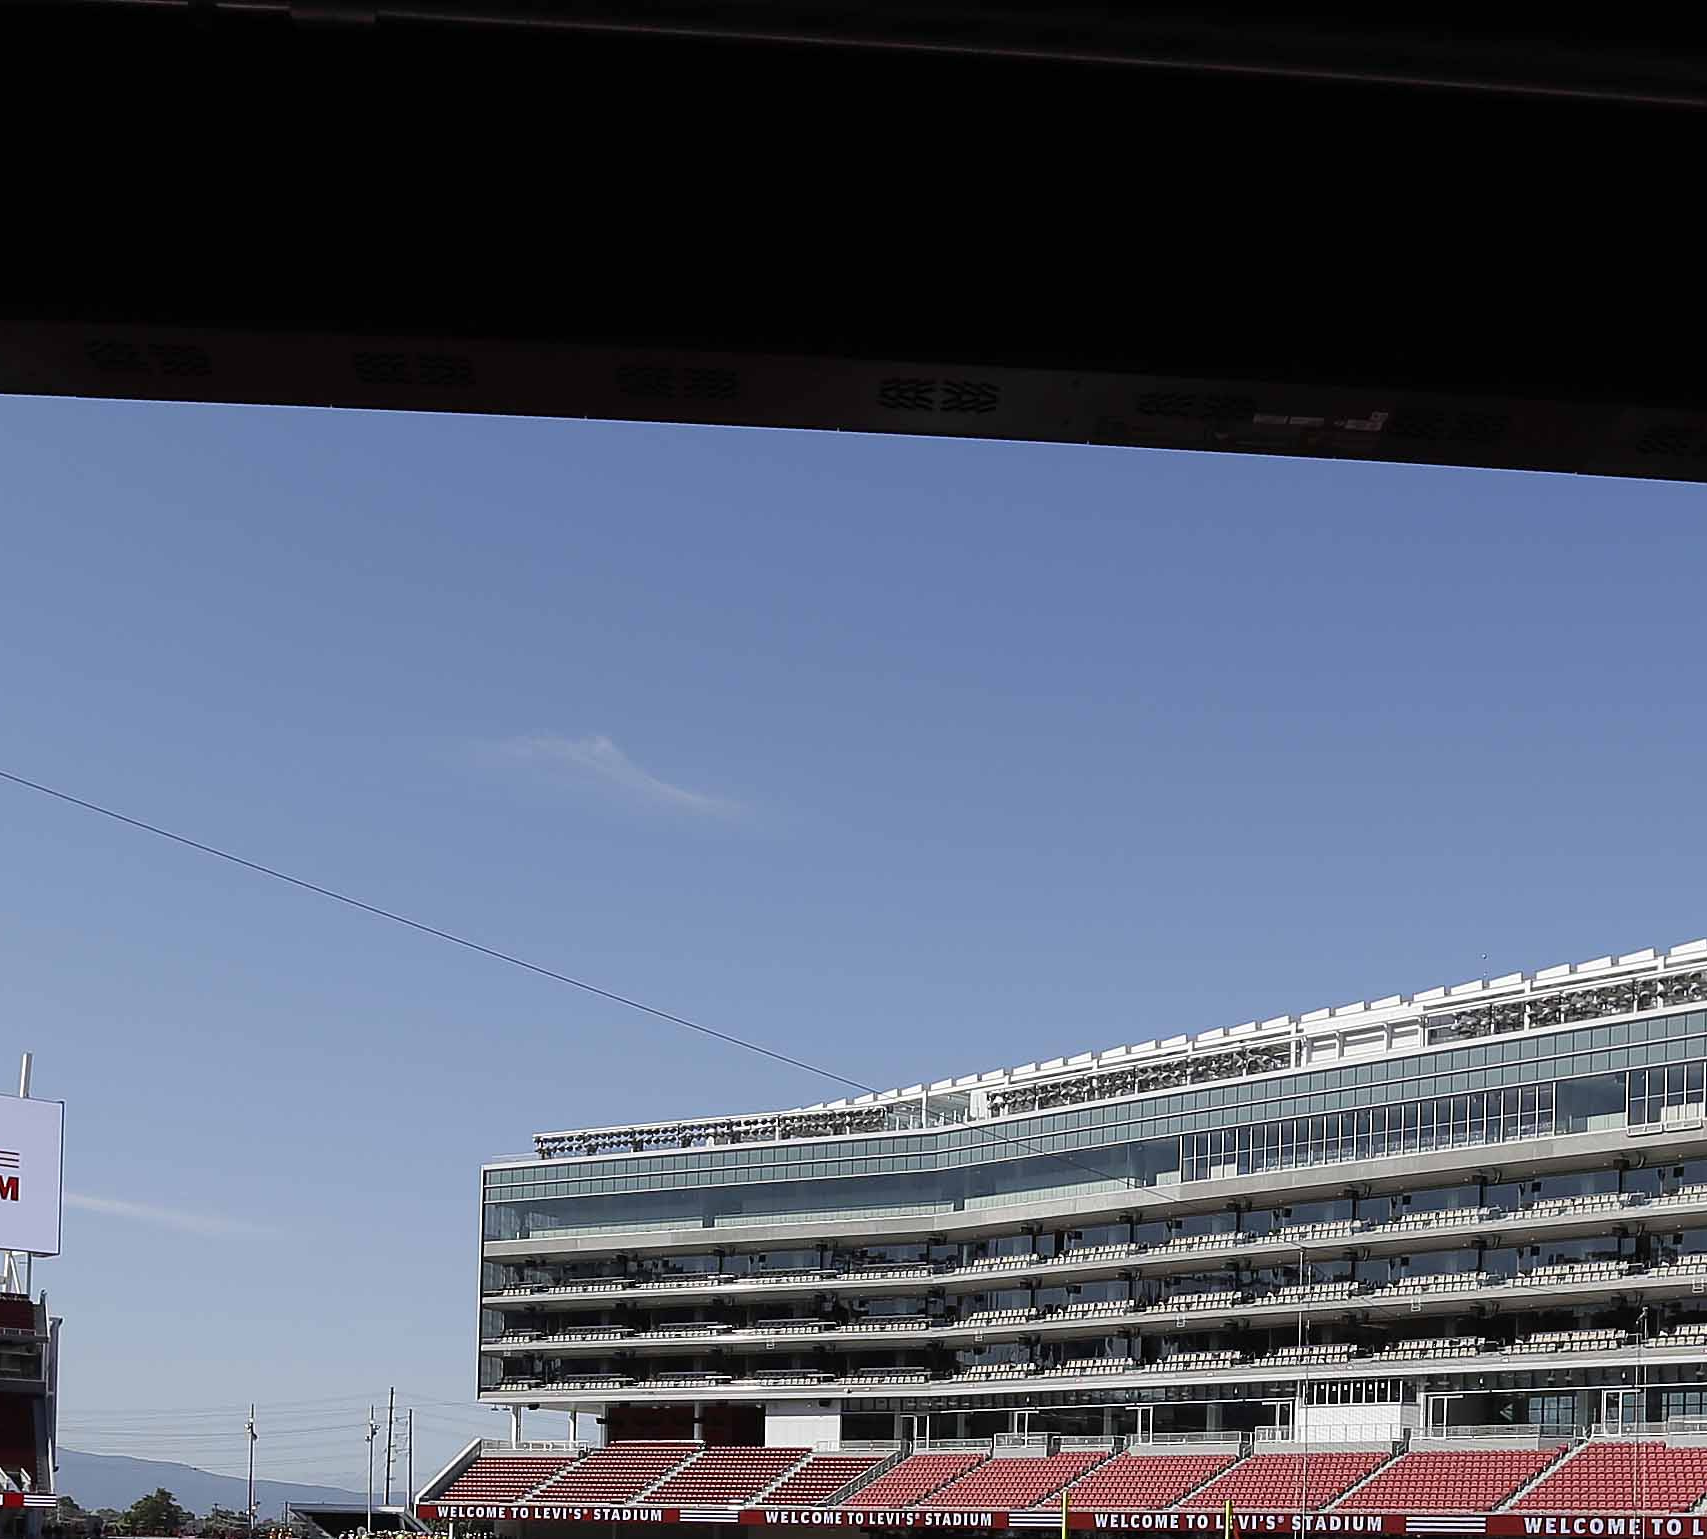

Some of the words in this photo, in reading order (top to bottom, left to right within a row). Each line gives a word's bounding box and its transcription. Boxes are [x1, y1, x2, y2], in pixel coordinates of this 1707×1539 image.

[437, 1505, 506, 1519] WELCOME
[510, 1506, 529, 1519] TO
[593, 1508, 663, 1522] STADIUM
[765, 1510, 842, 1524] WELCOME
[847, 1511, 864, 1525] TO
[924, 1512, 992, 1527] STADIUM
[1094, 1513, 1180, 1529] WELCOME
[1186, 1513, 1209, 1529] TO
[1291, 1514, 1383, 1532] STADIUM
[1523, 1516, 1641, 1535] WELCOME
[1651, 1517, 1682, 1537] TO
